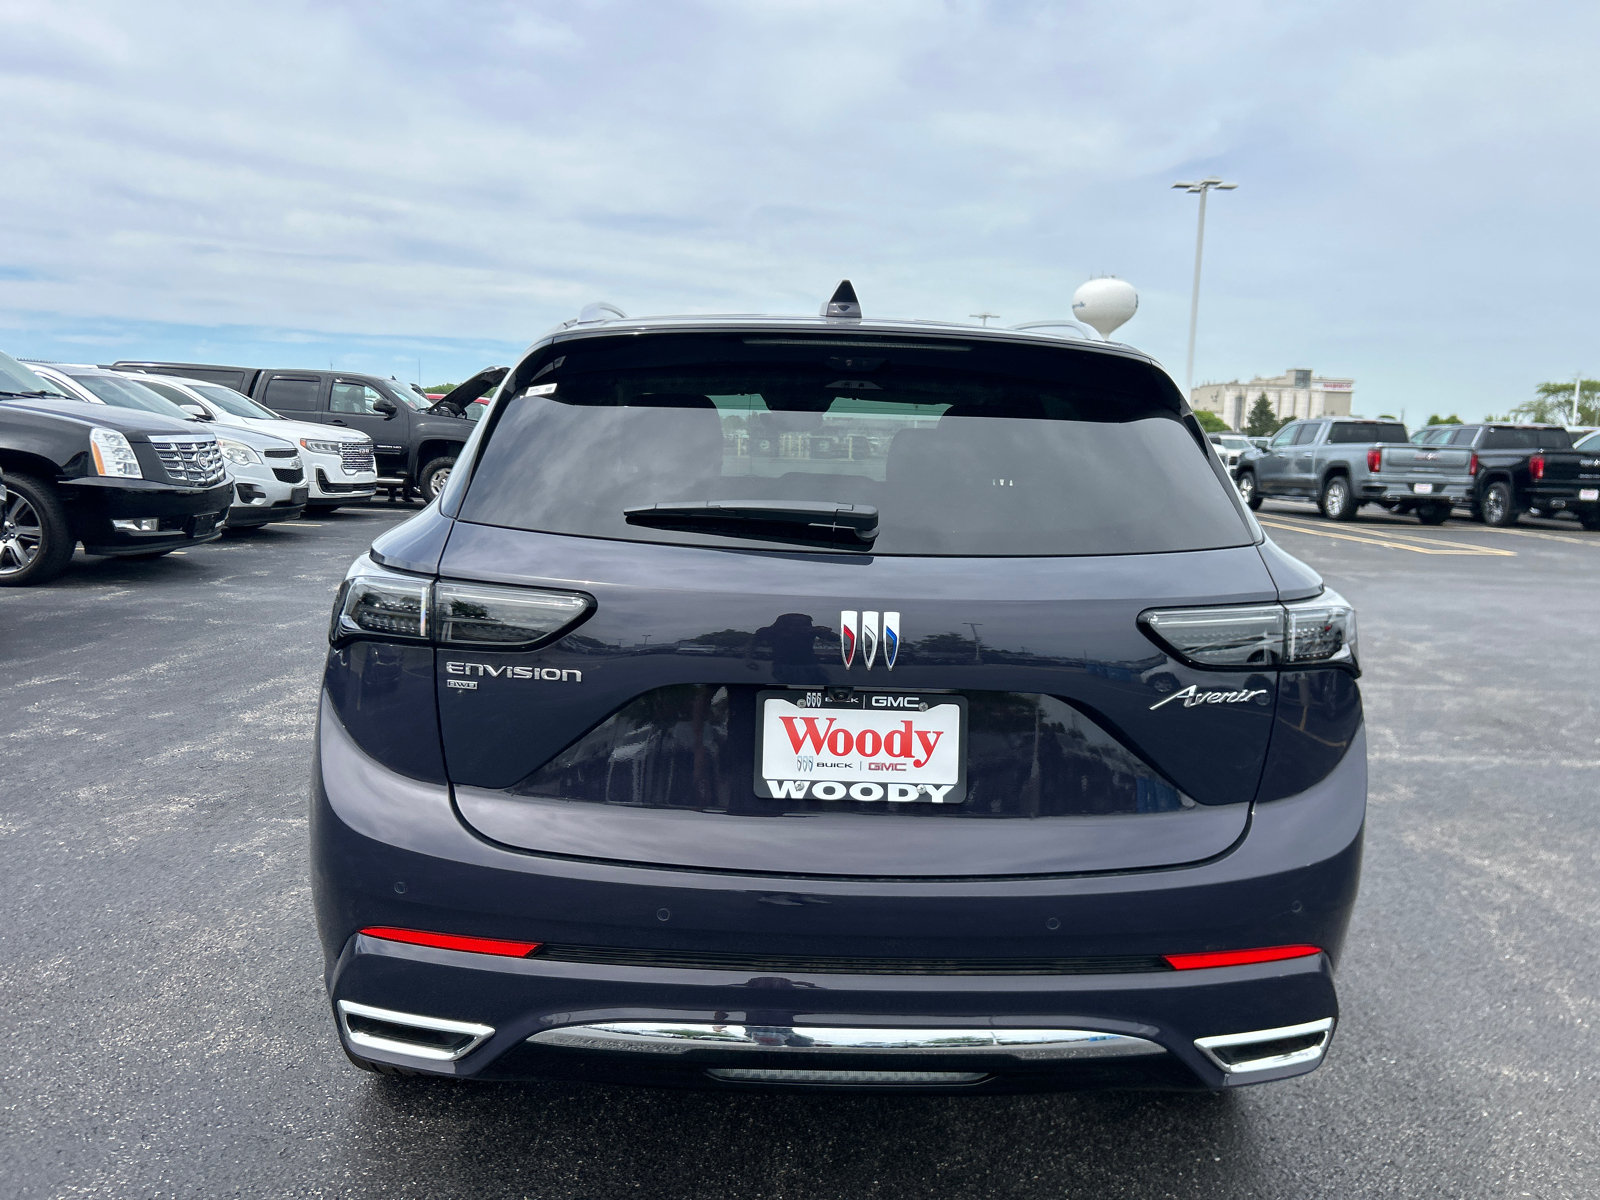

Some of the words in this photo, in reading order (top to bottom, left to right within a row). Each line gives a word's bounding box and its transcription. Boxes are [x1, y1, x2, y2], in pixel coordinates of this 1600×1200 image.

[871, 696, 920, 708] GMC
[1149, 685, 1267, 710] Avenir
[779, 716, 944, 768] Woody
[868, 762, 907, 771] GMC
[766, 780, 954, 803] WOODY
